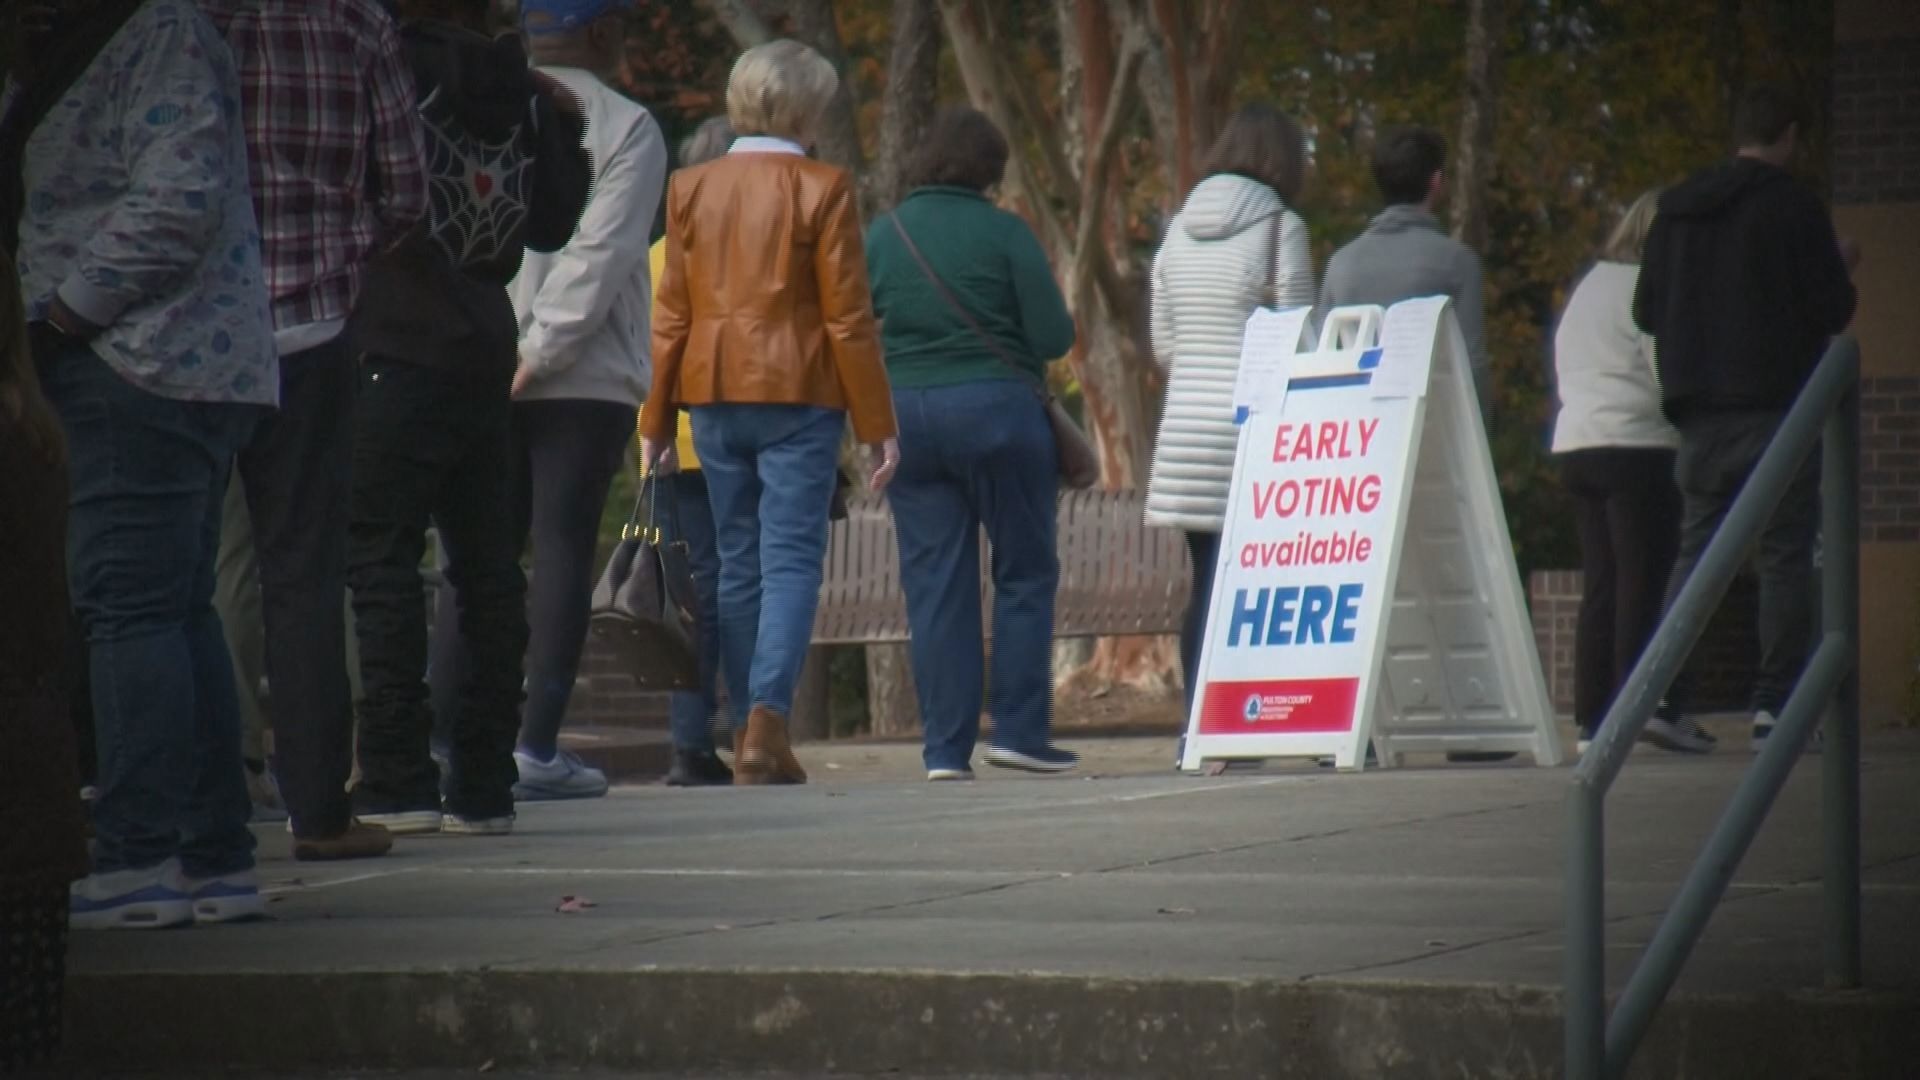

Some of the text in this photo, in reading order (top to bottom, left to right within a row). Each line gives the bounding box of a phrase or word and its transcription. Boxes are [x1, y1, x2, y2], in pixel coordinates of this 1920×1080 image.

[1273, 418, 1380, 462] EARLY
[1252, 475, 1381, 519] VOTING
[1241, 531, 1371, 568] available
[1228, 583, 1364, 646] HERE
[1288, 695, 1312, 704] COUNTY
